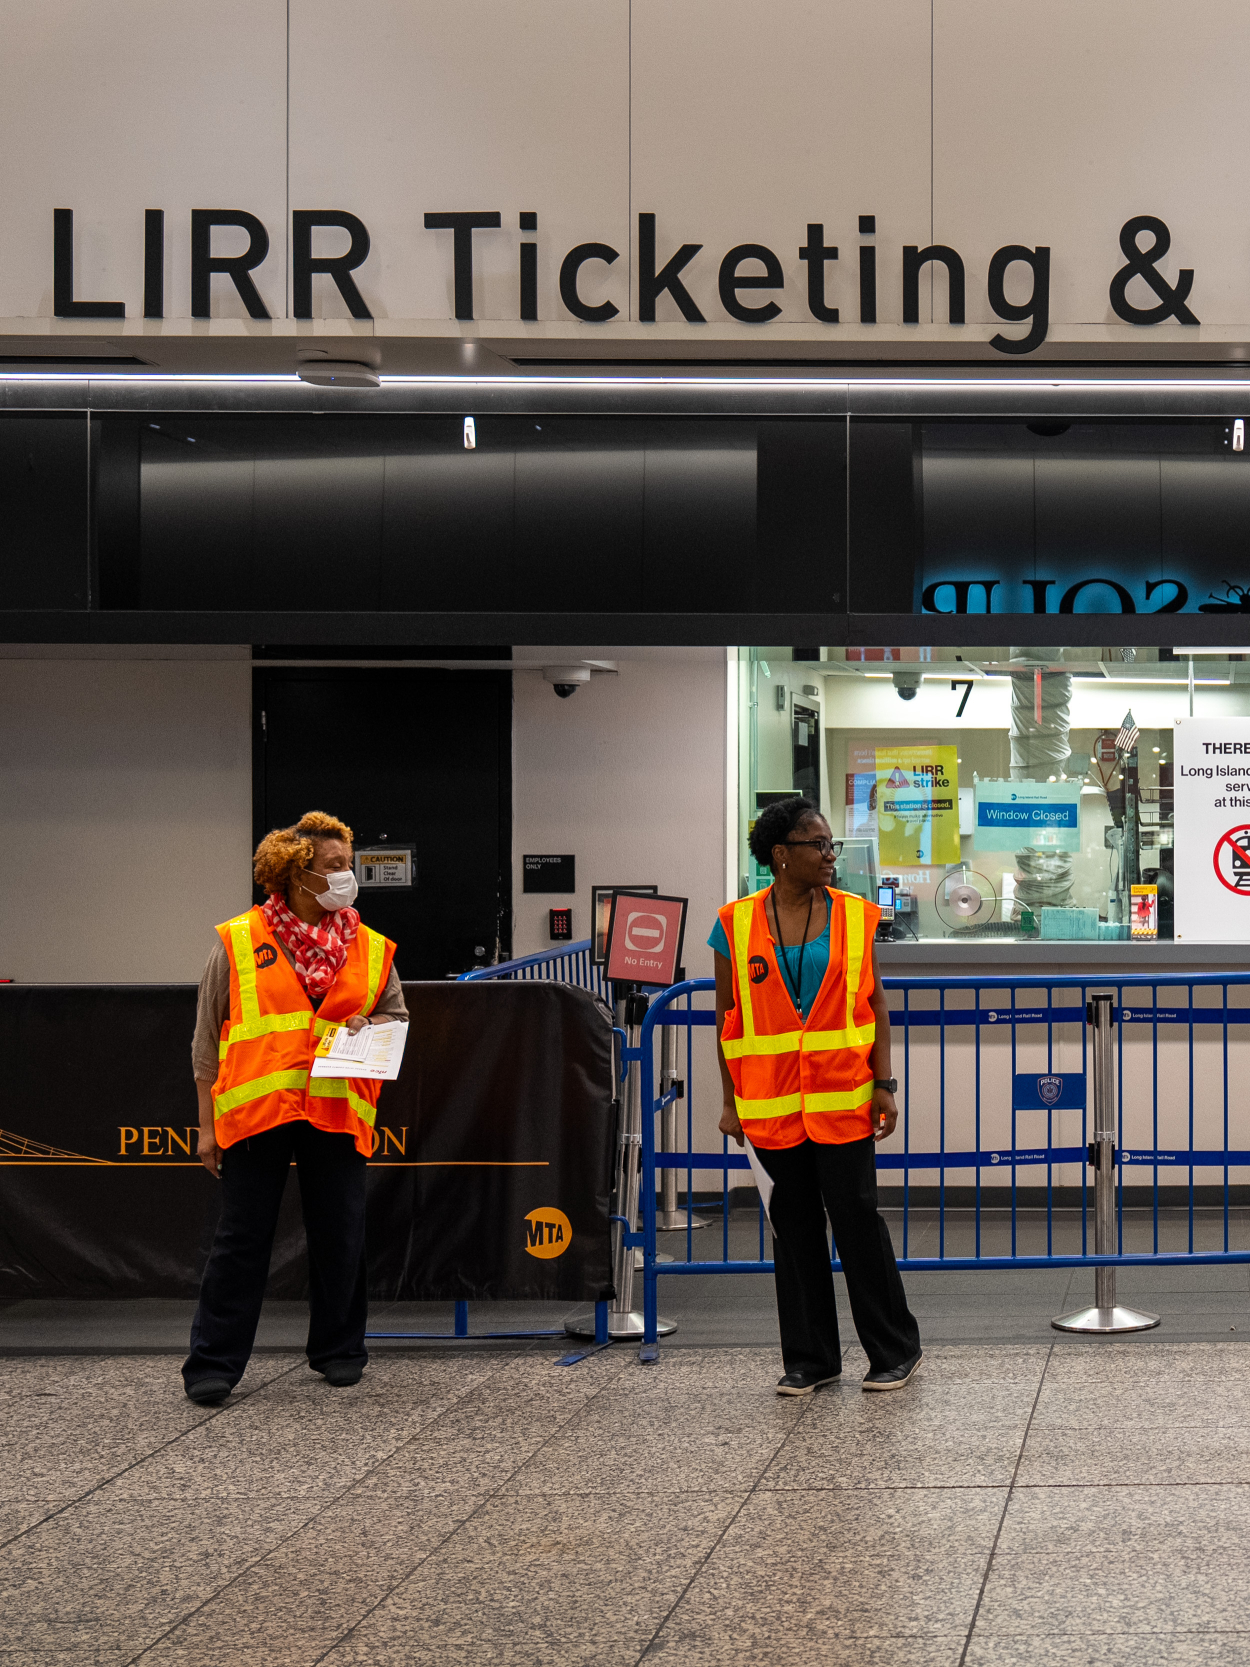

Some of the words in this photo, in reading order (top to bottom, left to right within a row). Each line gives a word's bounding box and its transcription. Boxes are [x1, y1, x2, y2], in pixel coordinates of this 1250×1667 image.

[53, 208, 373, 319] LIRR
[424, 211, 1050, 355] Ticketing
[1109, 215, 1200, 325] &
[951, 679, 973, 717] 7
[912, 765, 944, 777] LIRR
[1180, 765, 1213, 779] Long
[913, 777, 950, 788] strike
[1214, 796, 1226, 808] at
[986, 809, 1029, 820] Window
[1032, 810, 1068, 820] Closed
[253, 946, 275, 967] MTA
[624, 956, 637, 965] No
[640, 958, 662, 969] Entry
[748, 960, 766, 981] MTA
[1040, 1078, 1060, 1086] POLICE
[117, 1126, 200, 1156] PEN
[524, 1216, 566, 1250] MTA
